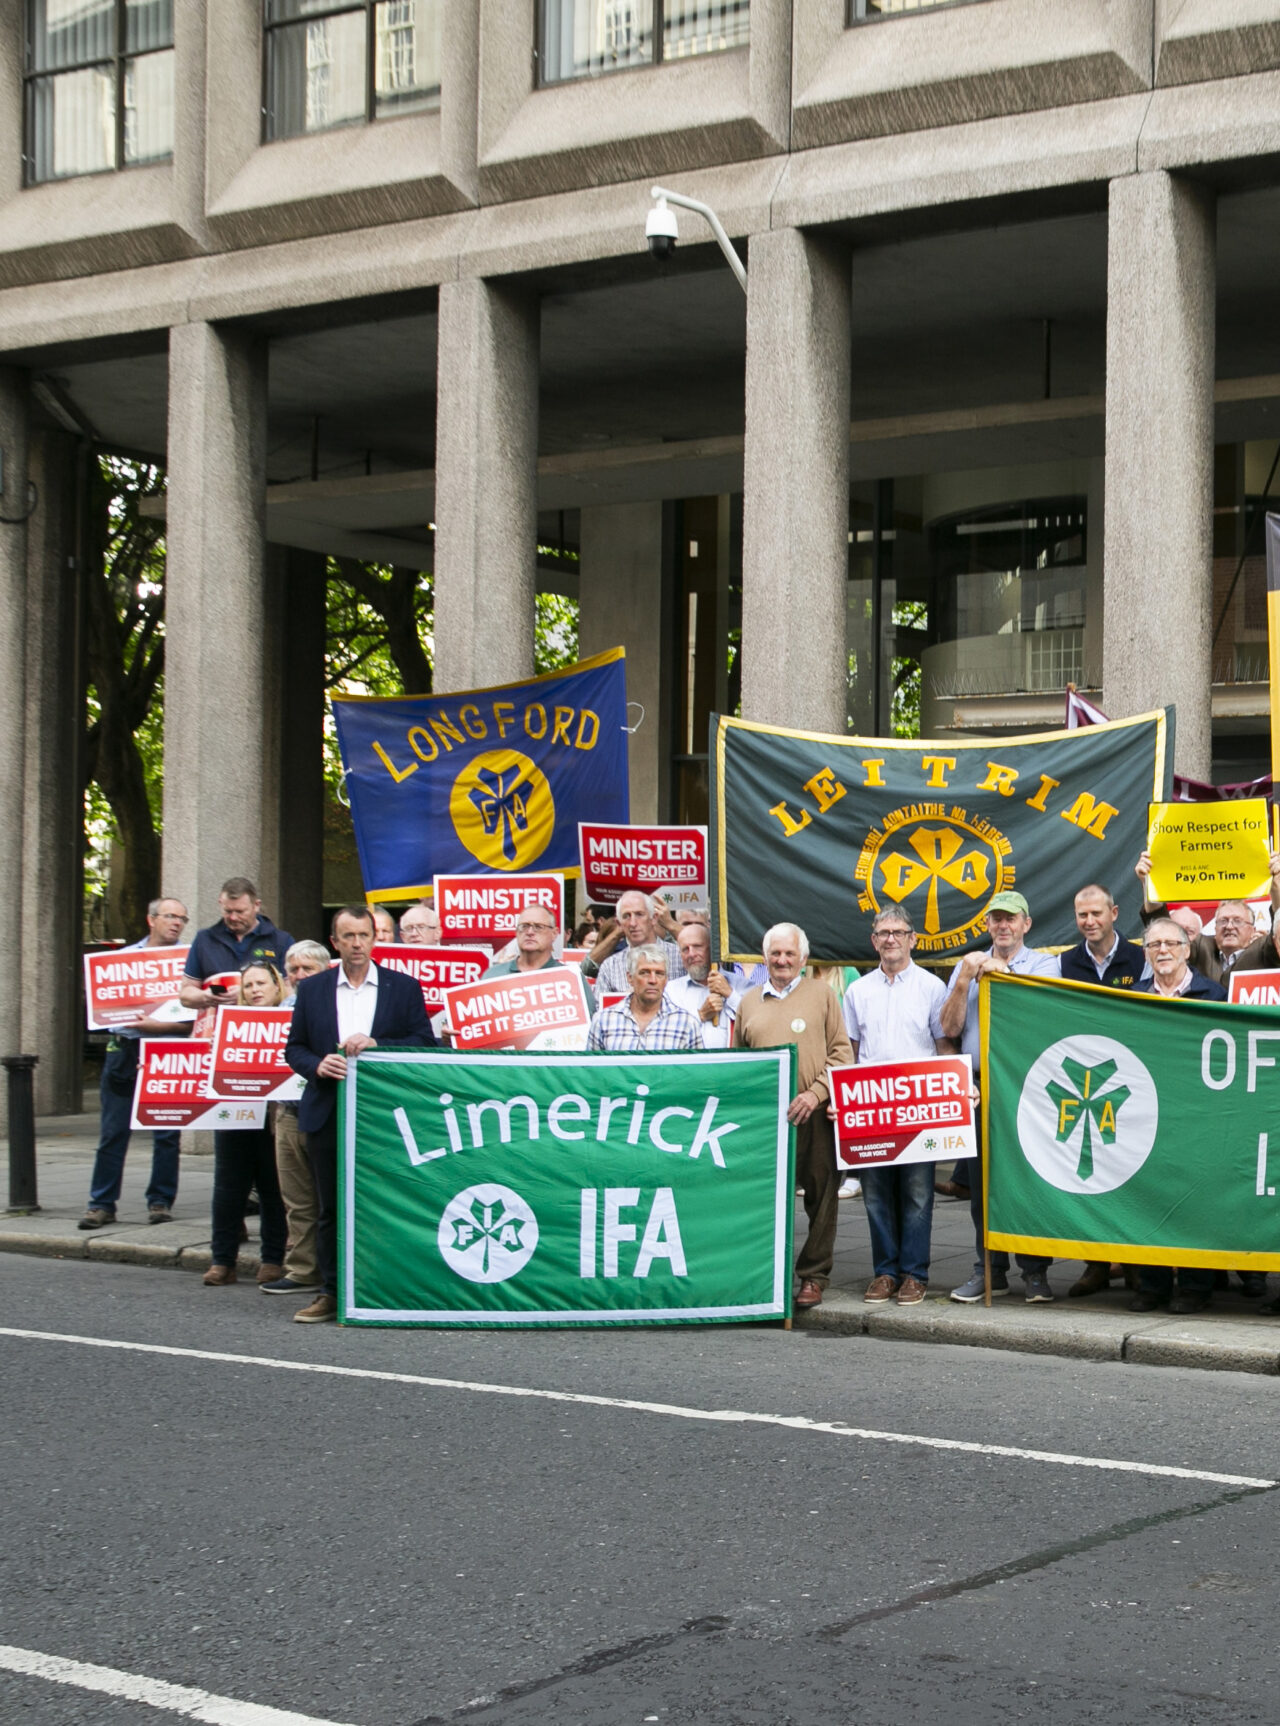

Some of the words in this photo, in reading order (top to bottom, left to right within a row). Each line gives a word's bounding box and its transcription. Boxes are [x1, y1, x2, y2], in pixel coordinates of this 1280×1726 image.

[372, 701, 600, 784] LONGFORD
[769, 755, 1119, 840] LEITRIM
[882, 802, 945, 830] AONTAITHE
[951, 806, 967, 821] NA
[1153, 821, 1184, 834] Show
[1187, 820, 1239, 835] Respect
[1243, 818, 1261, 830] for
[589, 836, 701, 861] MINISTER,
[1180, 840, 1233, 852] Farmers
[590, 862, 618, 876] GET
[622, 863, 635, 877] IT
[638, 865, 697, 878] SORTED
[1175, 872, 1196, 884] Pay
[1198, 871, 1215, 881] On
[1218, 870, 1246, 881] Time
[680, 892, 699, 903] IFA
[445, 914, 475, 929] GET
[478, 914, 492, 928] IT
[916, 932, 967, 951] ARMERS
[95, 958, 185, 983] MINISTE
[96, 985, 127, 1000] GET
[128, 984, 143, 997] IT
[145, 981, 182, 996] SORT
[455, 981, 578, 1022] MINISTER,
[226, 1021, 292, 1044] MINIS
[460, 1020, 492, 1041] GET
[495, 1016, 509, 1032] IT
[513, 1005, 578, 1030] SORTED
[149, 1053, 212, 1075] MINIS
[222, 1047, 257, 1064] GET
[258, 1049, 275, 1063] IT
[146, 1080, 179, 1094] GET
[180, 1080, 196, 1094] IT
[841, 1072, 965, 1106] MINISTER,
[235, 1109, 256, 1121] IFA
[844, 1110, 875, 1128] GET
[878, 1108, 893, 1125] IT
[896, 1101, 962, 1123] SORTED
[394, 1085, 741, 1169] Limerick
[864, 1142, 896, 1151] ASSOCIATION
[943, 1136, 966, 1149] IFA
[873, 1149, 887, 1157] VOICE
[580, 1187, 688, 1278] IFA
